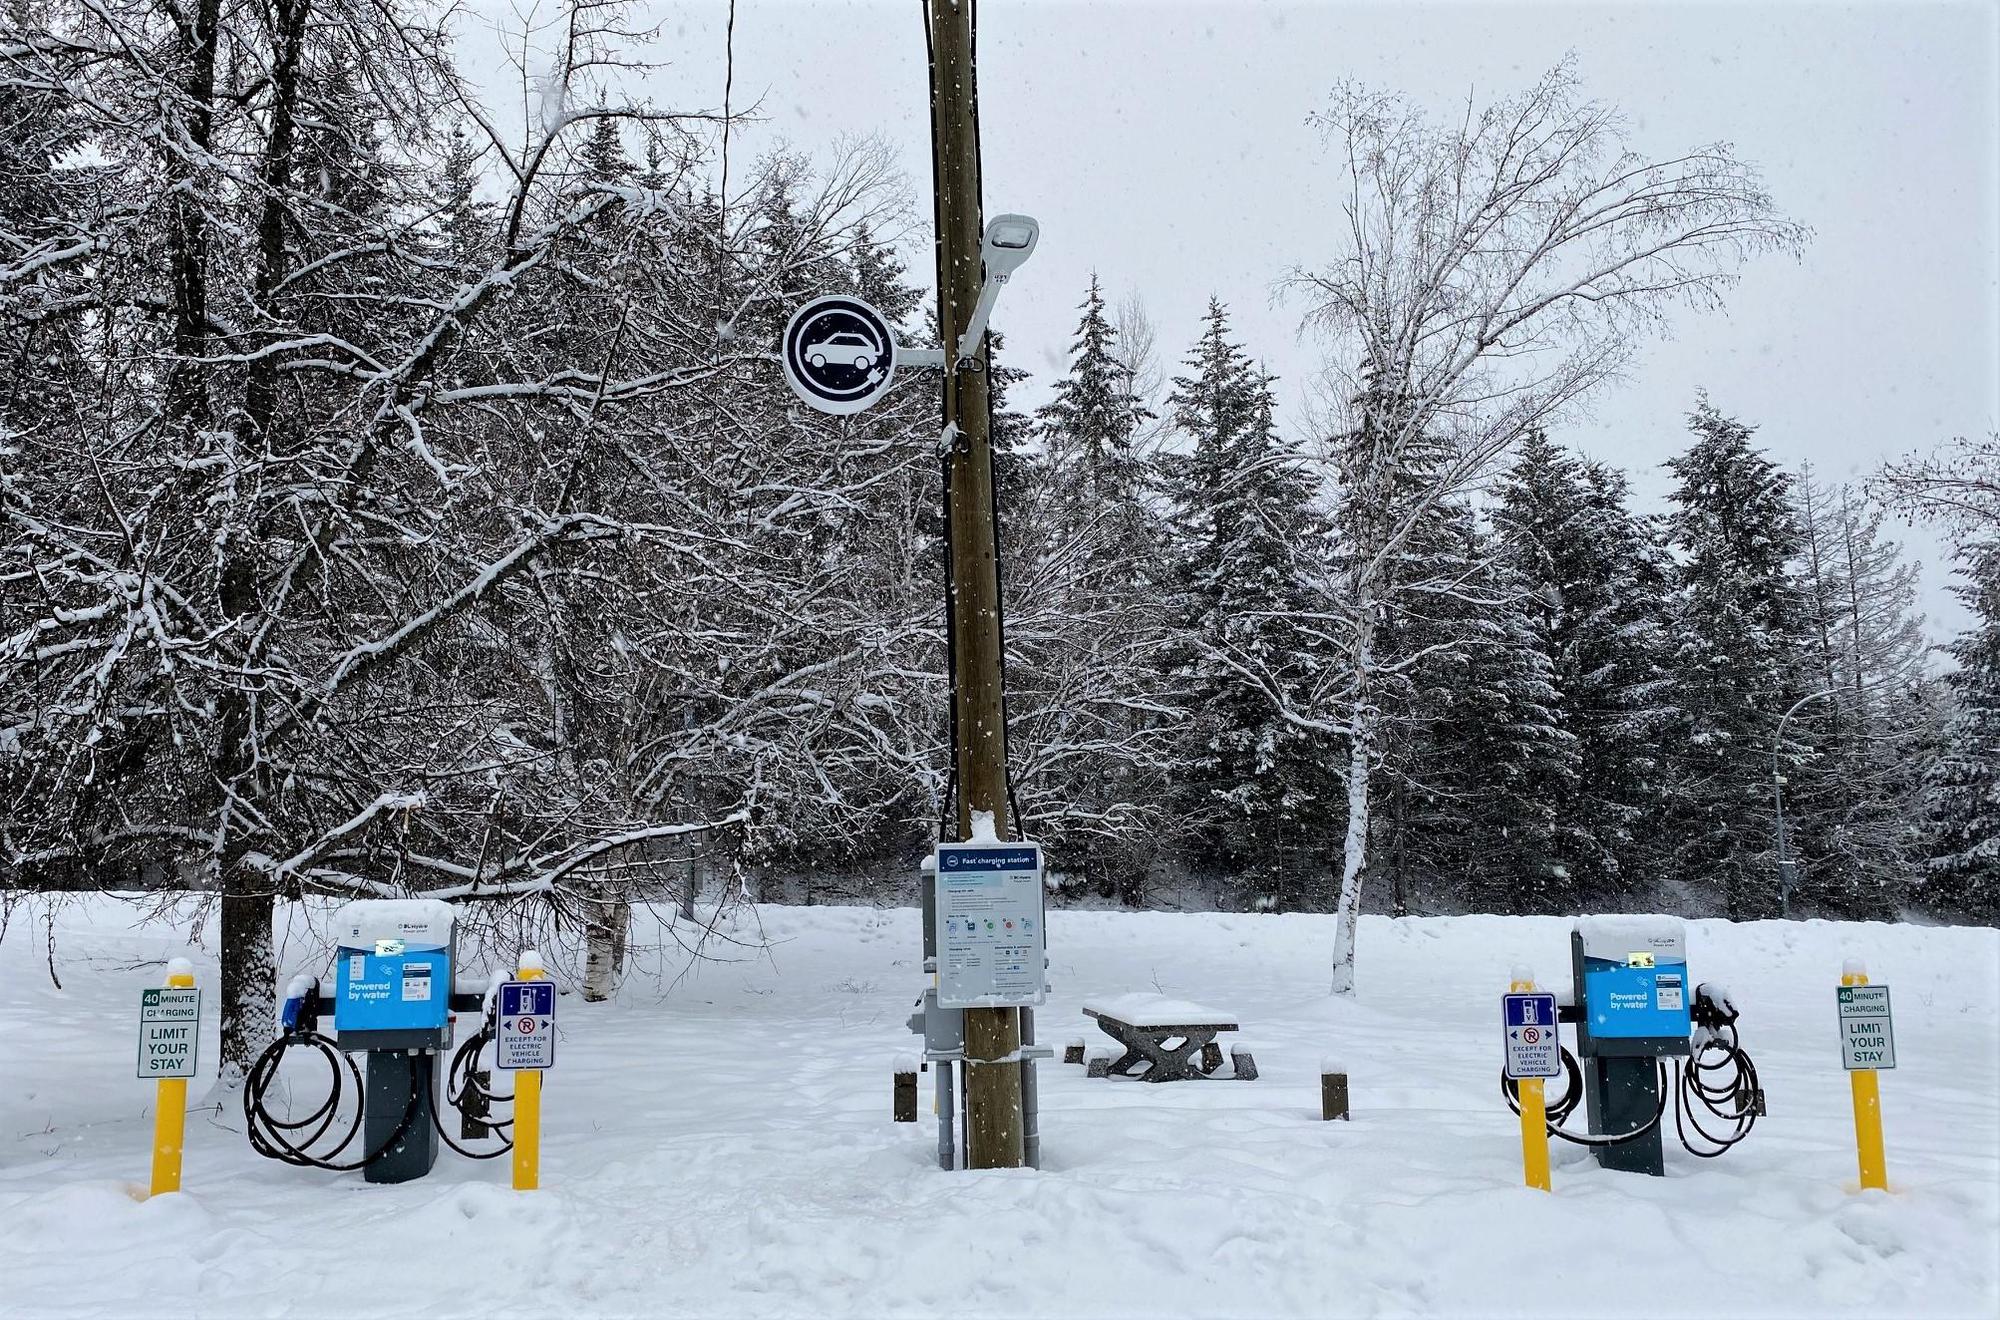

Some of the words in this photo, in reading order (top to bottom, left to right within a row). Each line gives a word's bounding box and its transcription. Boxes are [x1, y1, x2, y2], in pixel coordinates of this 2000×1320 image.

[962, 857, 976, 865] Fast
[978, 857, 1006, 866] charging
[1007, 856, 1030, 864] station
[349, 981, 391, 991] Powered
[144, 993, 159, 1004] 40
[160, 995, 195, 1003] MINUTE
[348, 990, 360, 1001] by
[362, 991, 391, 1000] water
[1610, 992, 1648, 1001] Powered
[1839, 991, 1852, 1001] 40
[1610, 1001, 1621, 1010] by
[1623, 1001, 1648, 1009] water
[1843, 1005, 1886, 1013] CHARGING
[150, 1028, 188, 1040] LIMIT
[1849, 1023, 1883, 1034] LIMIT
[1849, 1037, 1886, 1048] YOUR
[148, 1043, 188, 1055] YOUR
[1853, 1051, 1884, 1062] STAY
[150, 1058, 185, 1070] STAY
